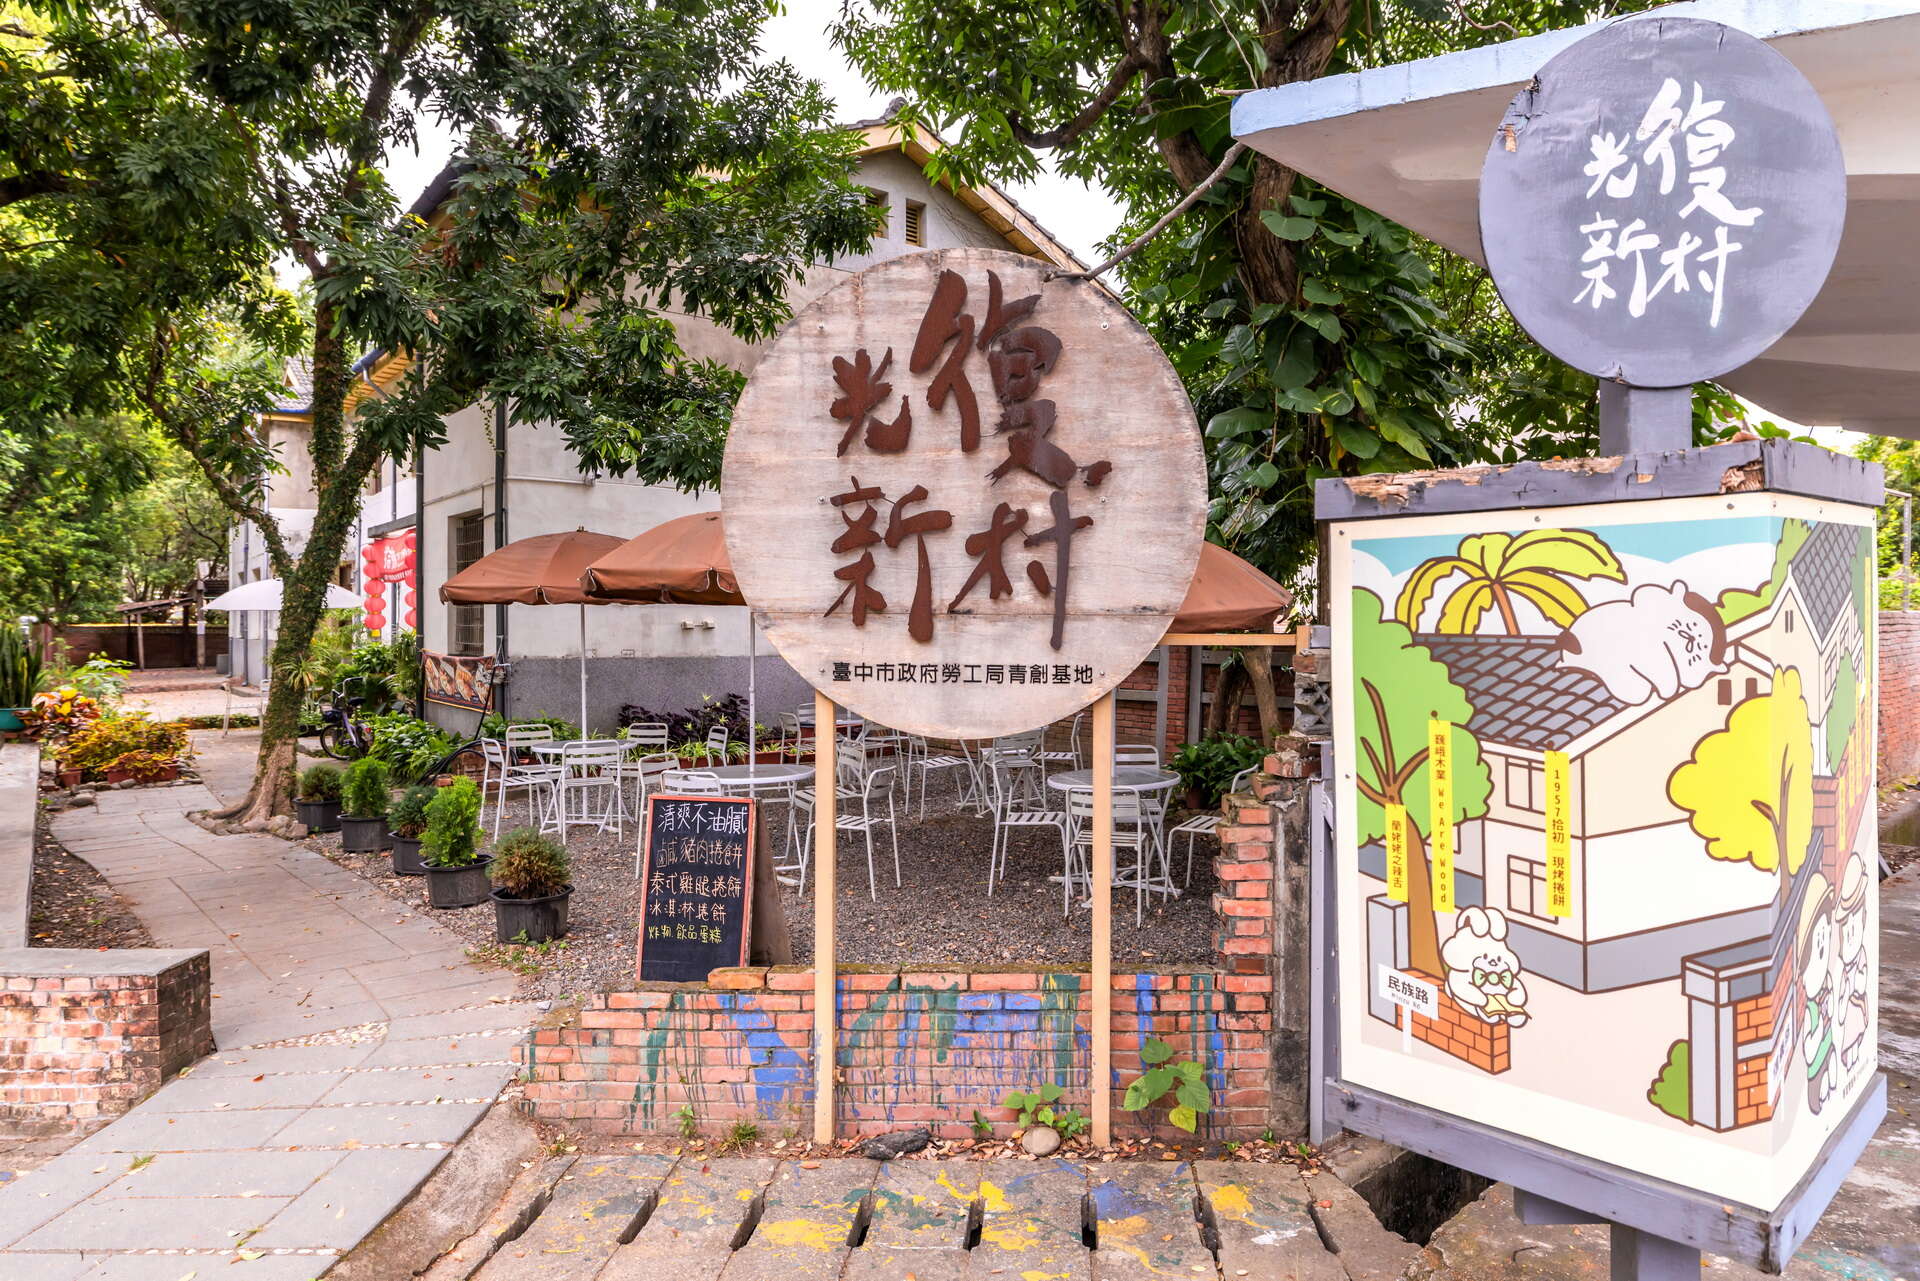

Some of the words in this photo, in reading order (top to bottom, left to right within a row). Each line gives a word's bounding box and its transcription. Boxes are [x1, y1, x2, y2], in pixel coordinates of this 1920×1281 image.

[1583, 77, 1764, 227] 光復
[1572, 211, 1743, 328] 新村
[829, 268, 1113, 488] 光復
[823, 475, 1094, 651] 新村
[832, 661, 1094, 685] 臺中市政府勞工局青創基地
[650, 870, 742, 899] 泰式雞腿捲餅
[1439, 858, 1447, 903] Wood
[1388, 975, 1429, 1004] 民族路
